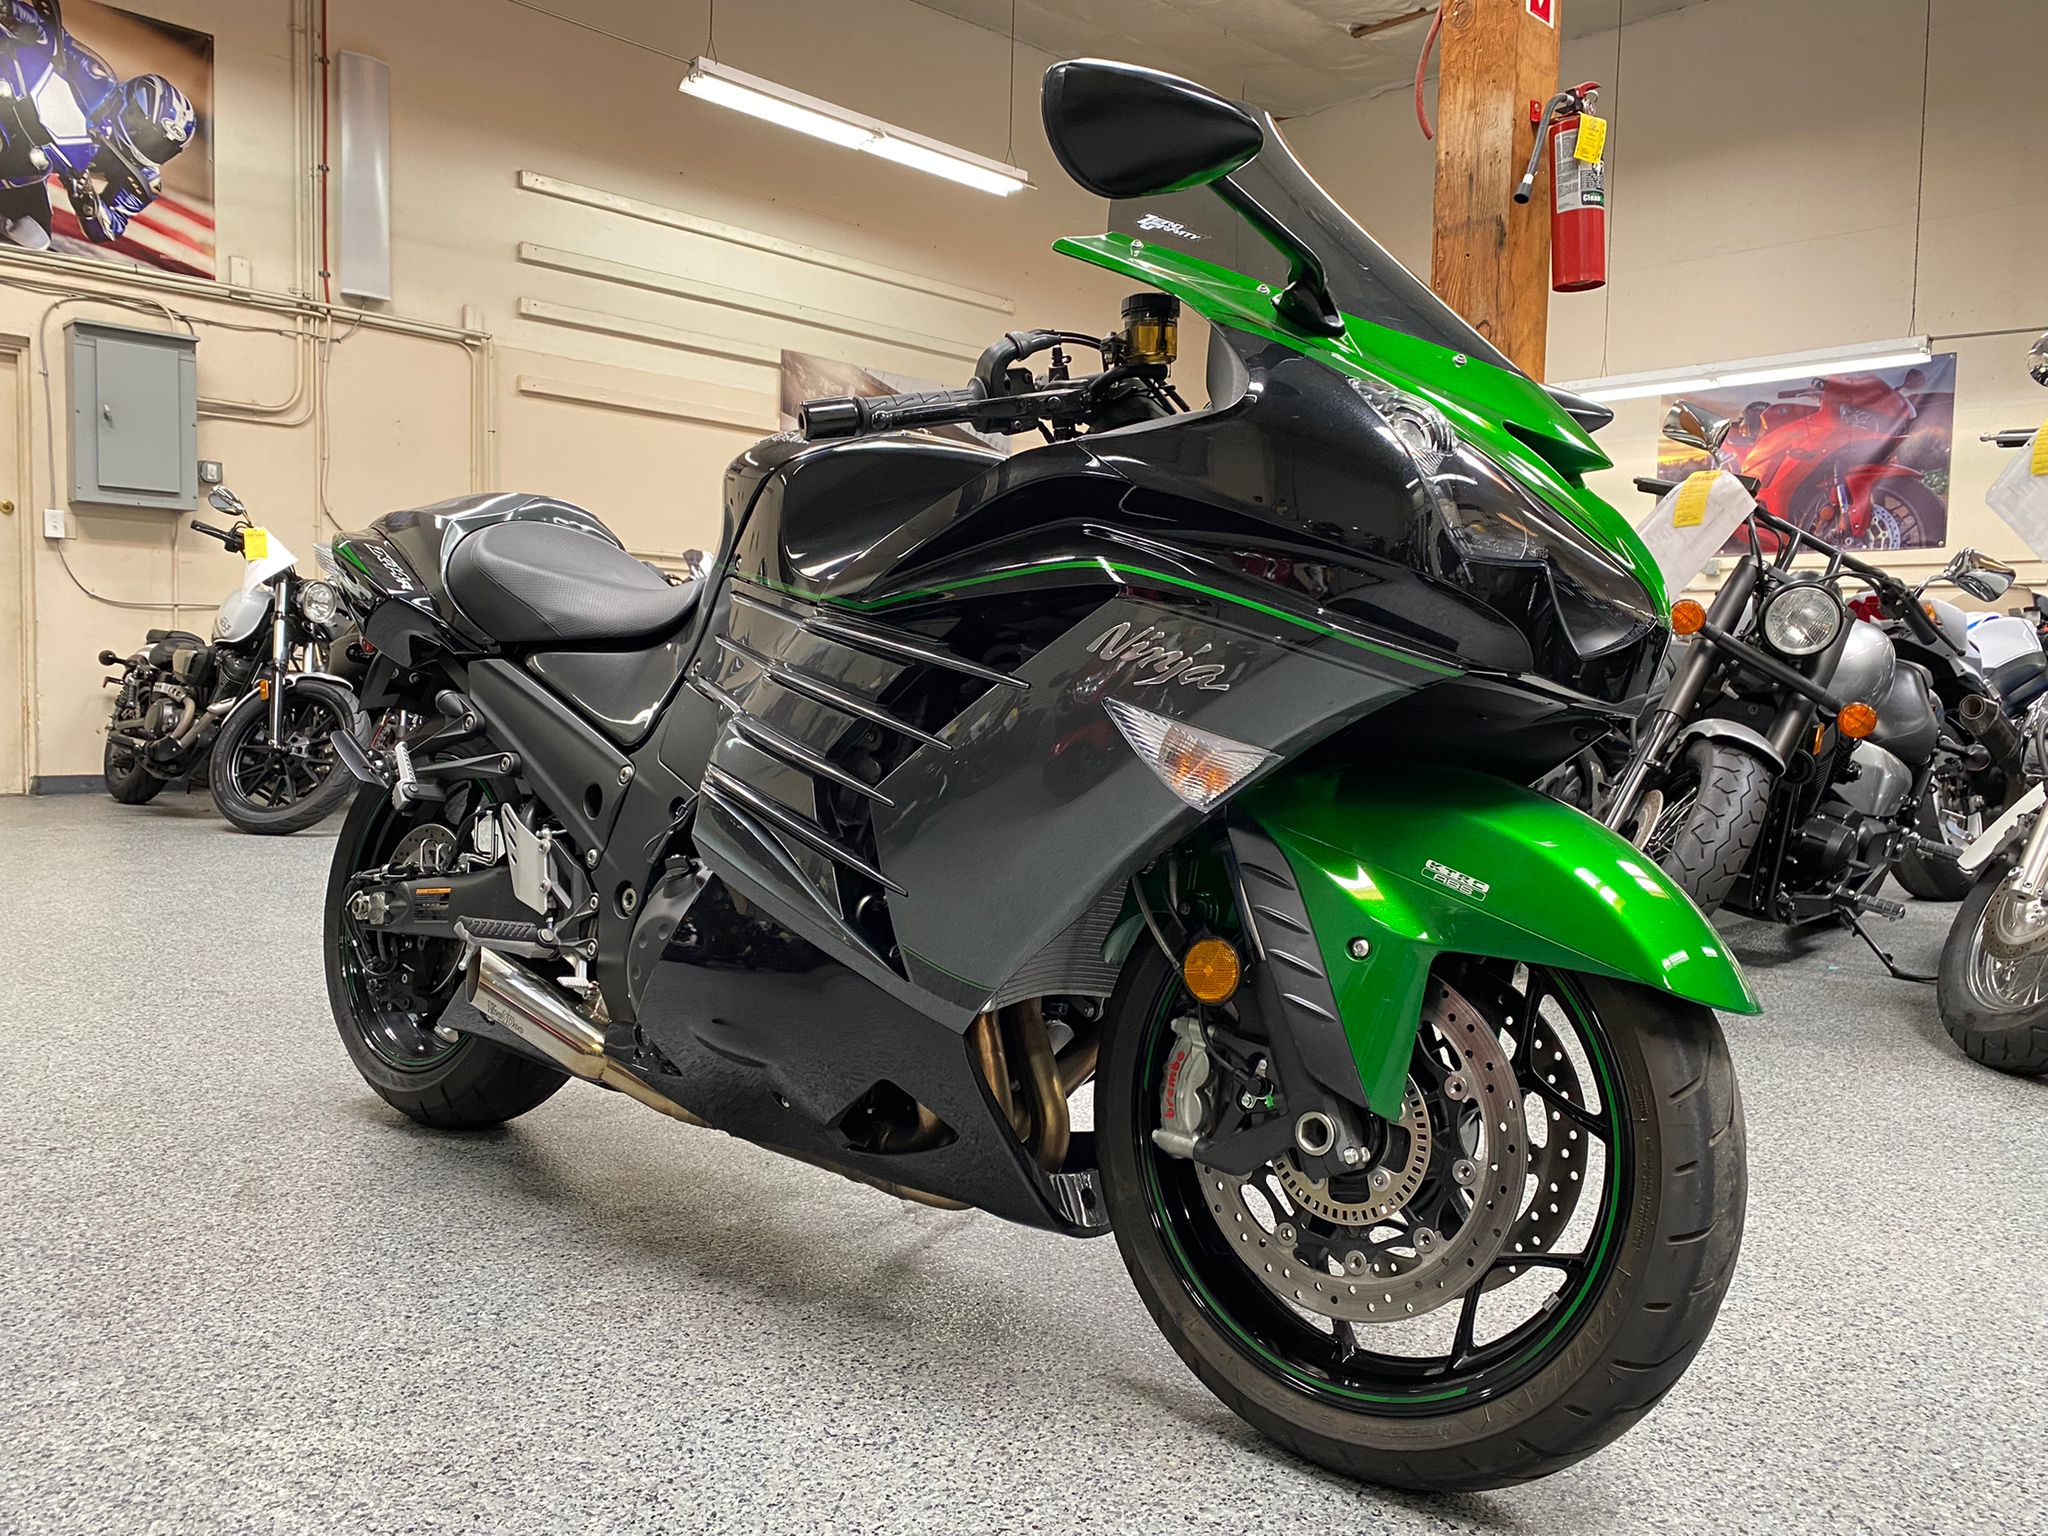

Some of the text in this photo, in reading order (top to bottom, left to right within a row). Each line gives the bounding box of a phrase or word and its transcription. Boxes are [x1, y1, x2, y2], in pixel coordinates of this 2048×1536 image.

[1086, 621, 1230, 691] Ninja
[1433, 873, 1474, 895] ABS
[1164, 1050, 1185, 1119] brembo
